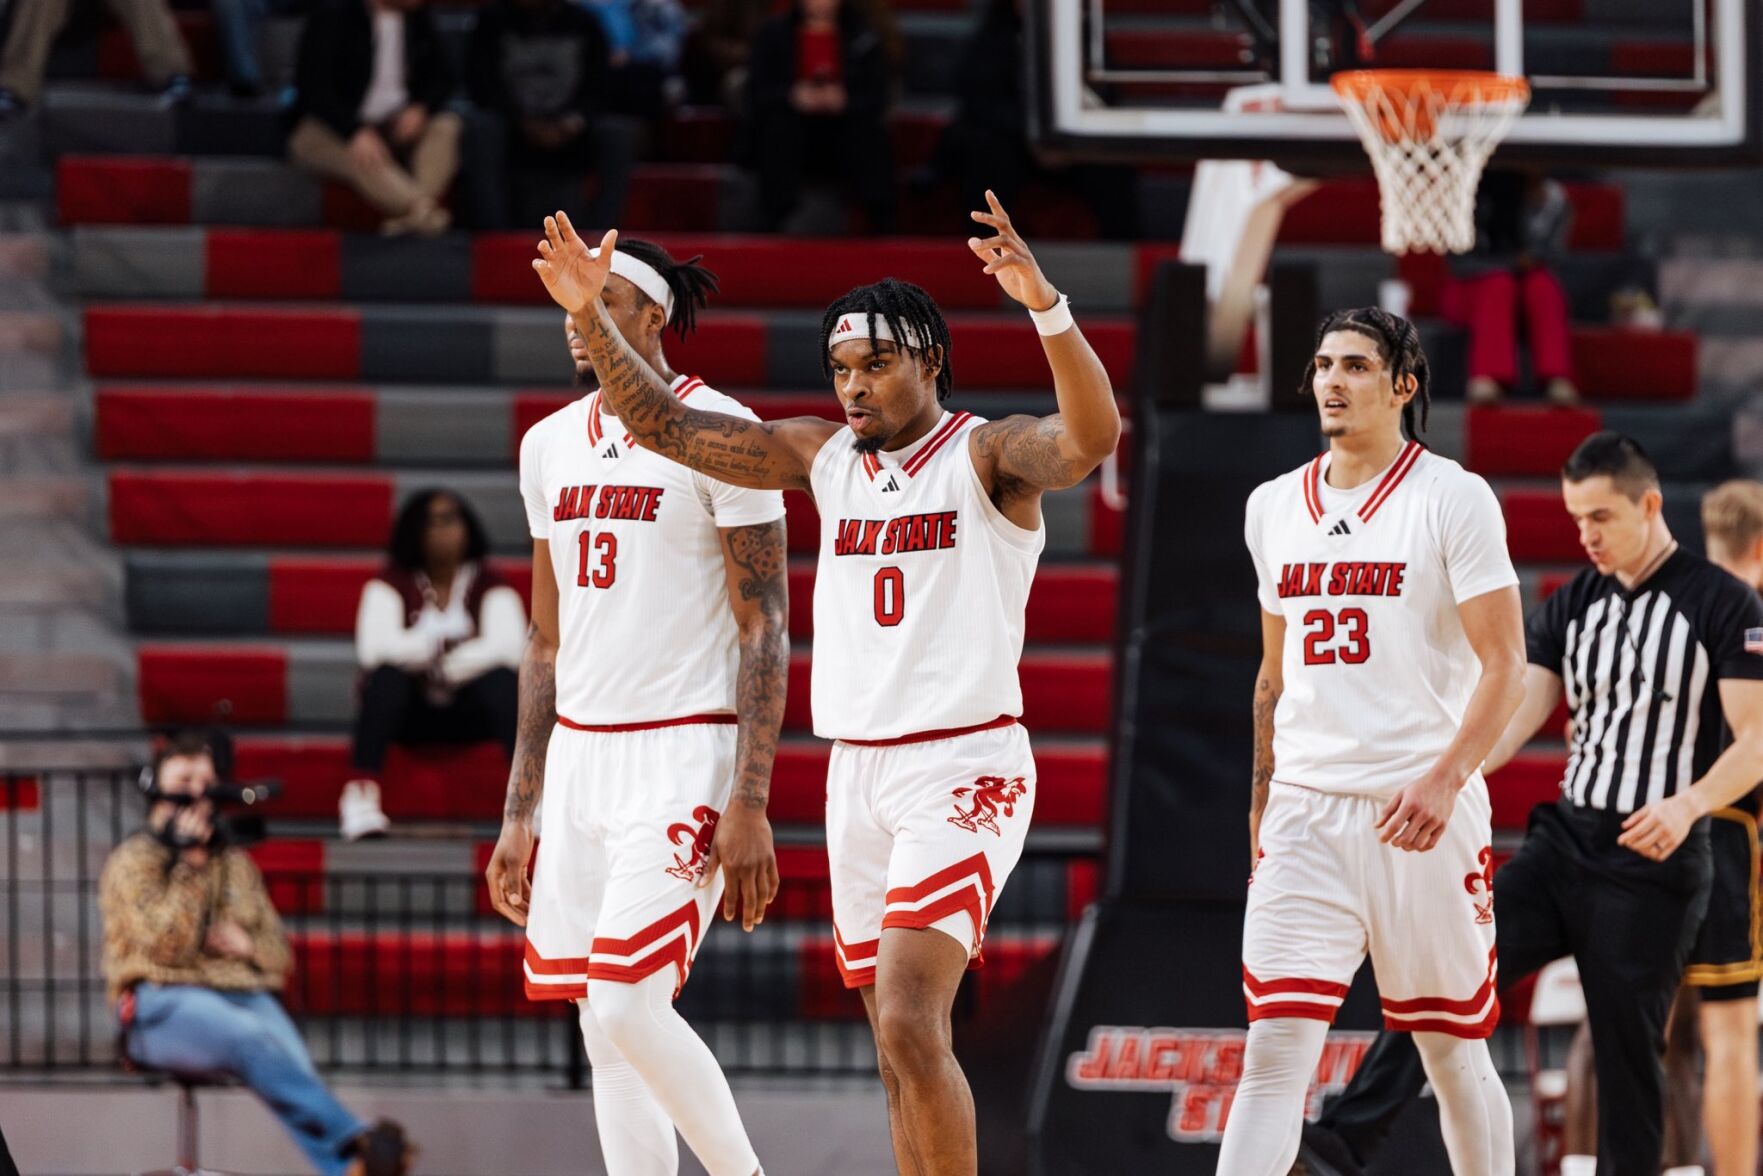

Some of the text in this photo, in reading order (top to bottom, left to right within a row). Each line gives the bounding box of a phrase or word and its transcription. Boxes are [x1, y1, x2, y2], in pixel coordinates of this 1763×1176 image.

[554, 485, 665, 522] JAX STATE
[835, 510, 958, 556] JAX STATE
[577, 530, 618, 589] 13
[1277, 561, 1407, 598] JAX STATE
[874, 566, 905, 627] 0
[1303, 607, 1370, 666] 23
